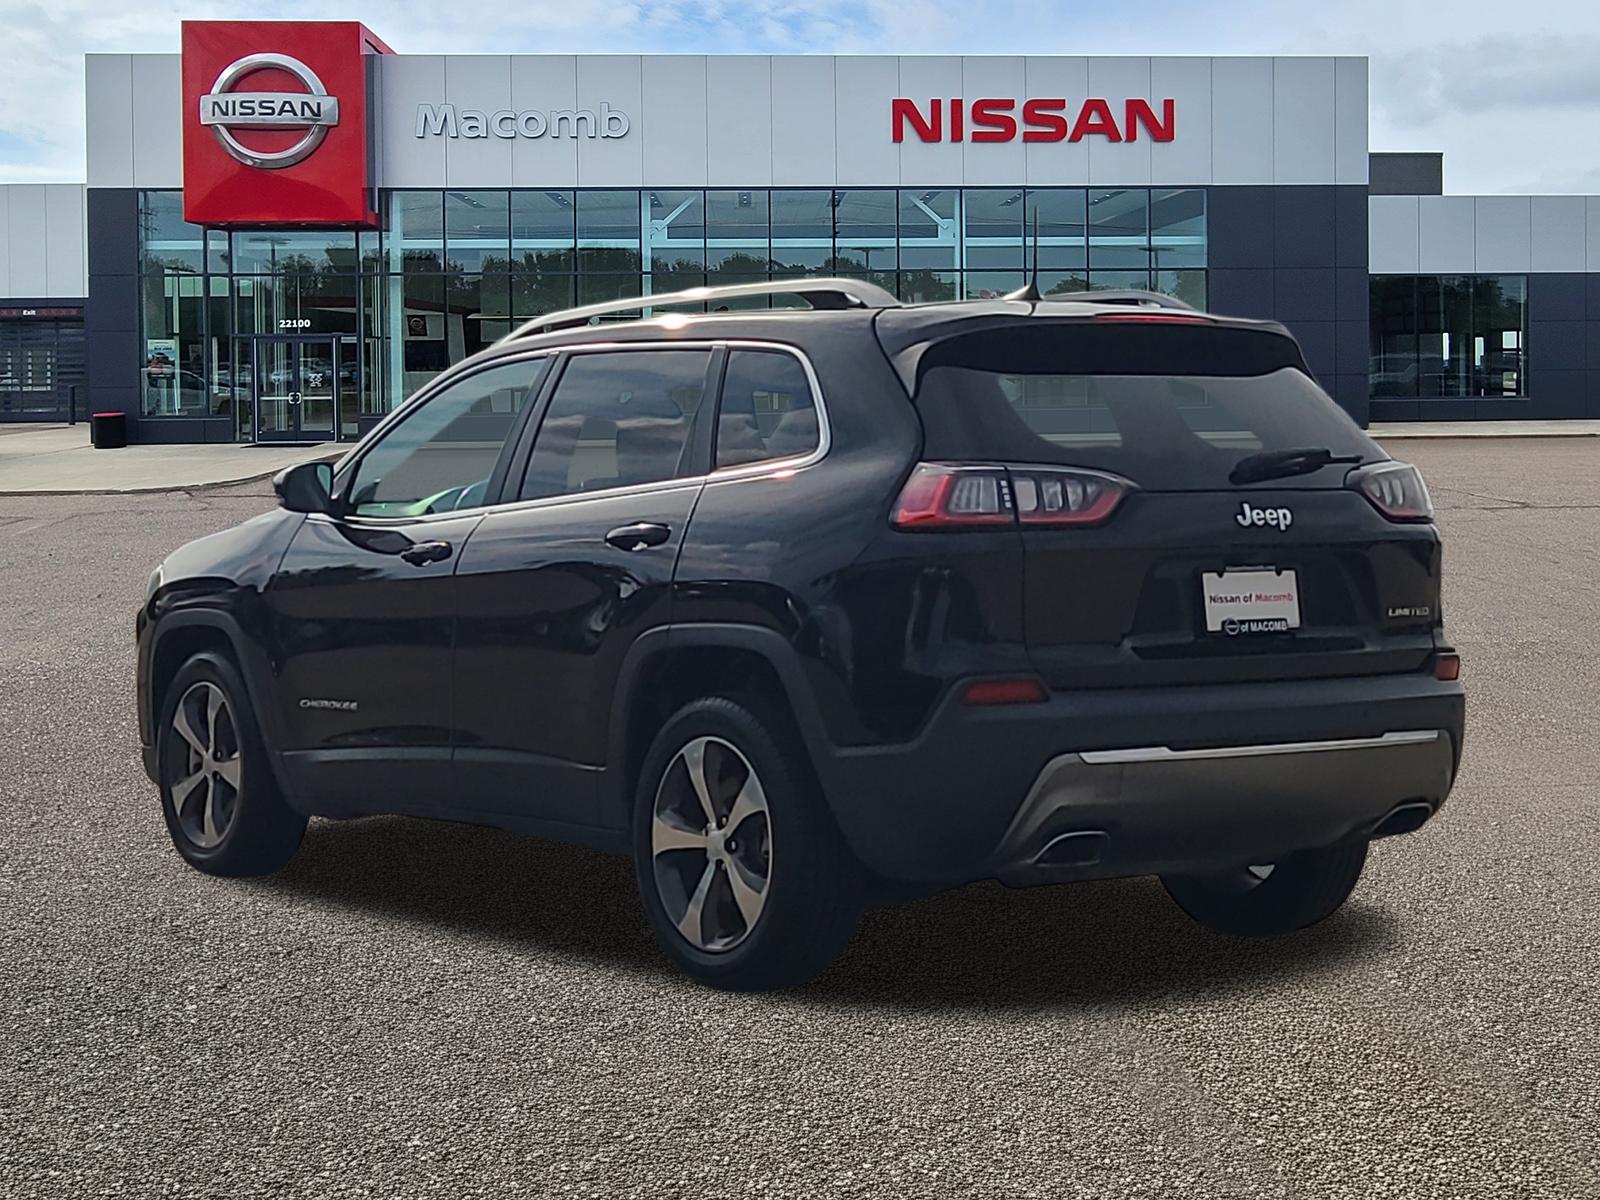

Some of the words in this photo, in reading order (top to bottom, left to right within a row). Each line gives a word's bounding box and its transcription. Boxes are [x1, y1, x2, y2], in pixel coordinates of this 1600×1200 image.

[212, 99, 322, 118] NISSAN
[415, 102, 630, 139] Macomb
[892, 98, 1175, 143] NISSAN
[22, 308, 37, 316] Exit
[279, 319, 311, 328] 22100
[1236, 503, 1292, 530] Jeep
[1209, 594, 1241, 604] Nissan
[1243, 593, 1253, 603] of
[1255, 593, 1293, 602] Macomb
[1250, 620, 1287, 632] MACOMB
[299, 699, 358, 711] CHEROKEE
